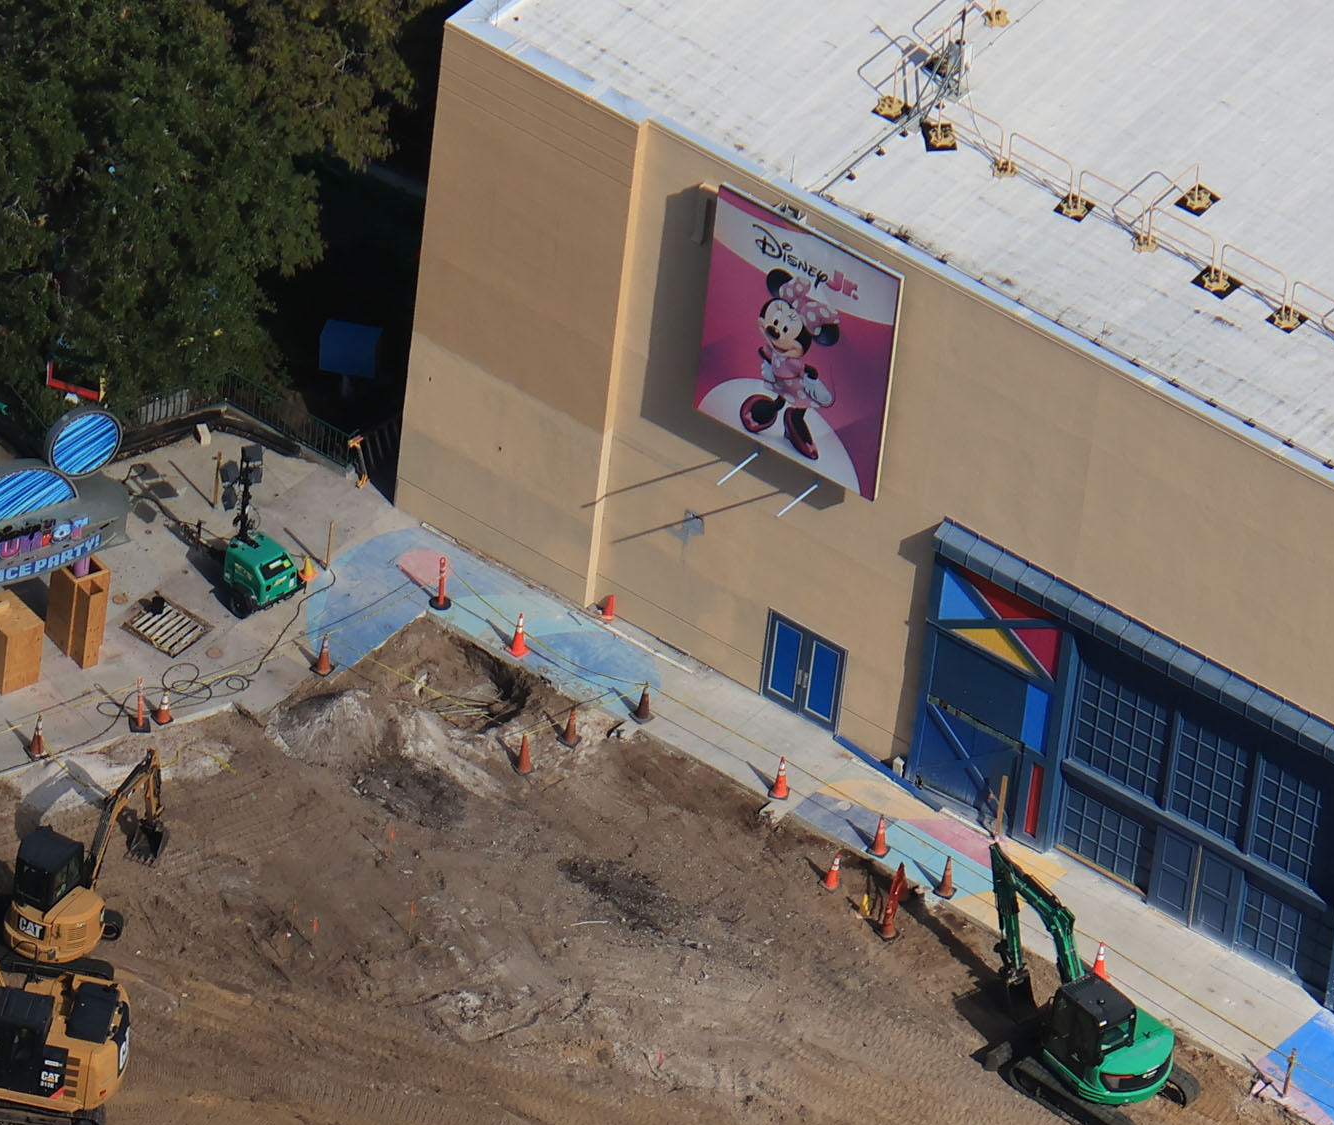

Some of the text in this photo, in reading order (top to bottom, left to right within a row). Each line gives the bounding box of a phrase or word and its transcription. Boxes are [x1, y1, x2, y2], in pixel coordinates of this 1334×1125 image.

[826, 270, 859, 301] Jr.
[34, 534, 100, 573] PARTY!
[18, 916, 43, 939] CAT
[40, 1070, 61, 1083] CAT
